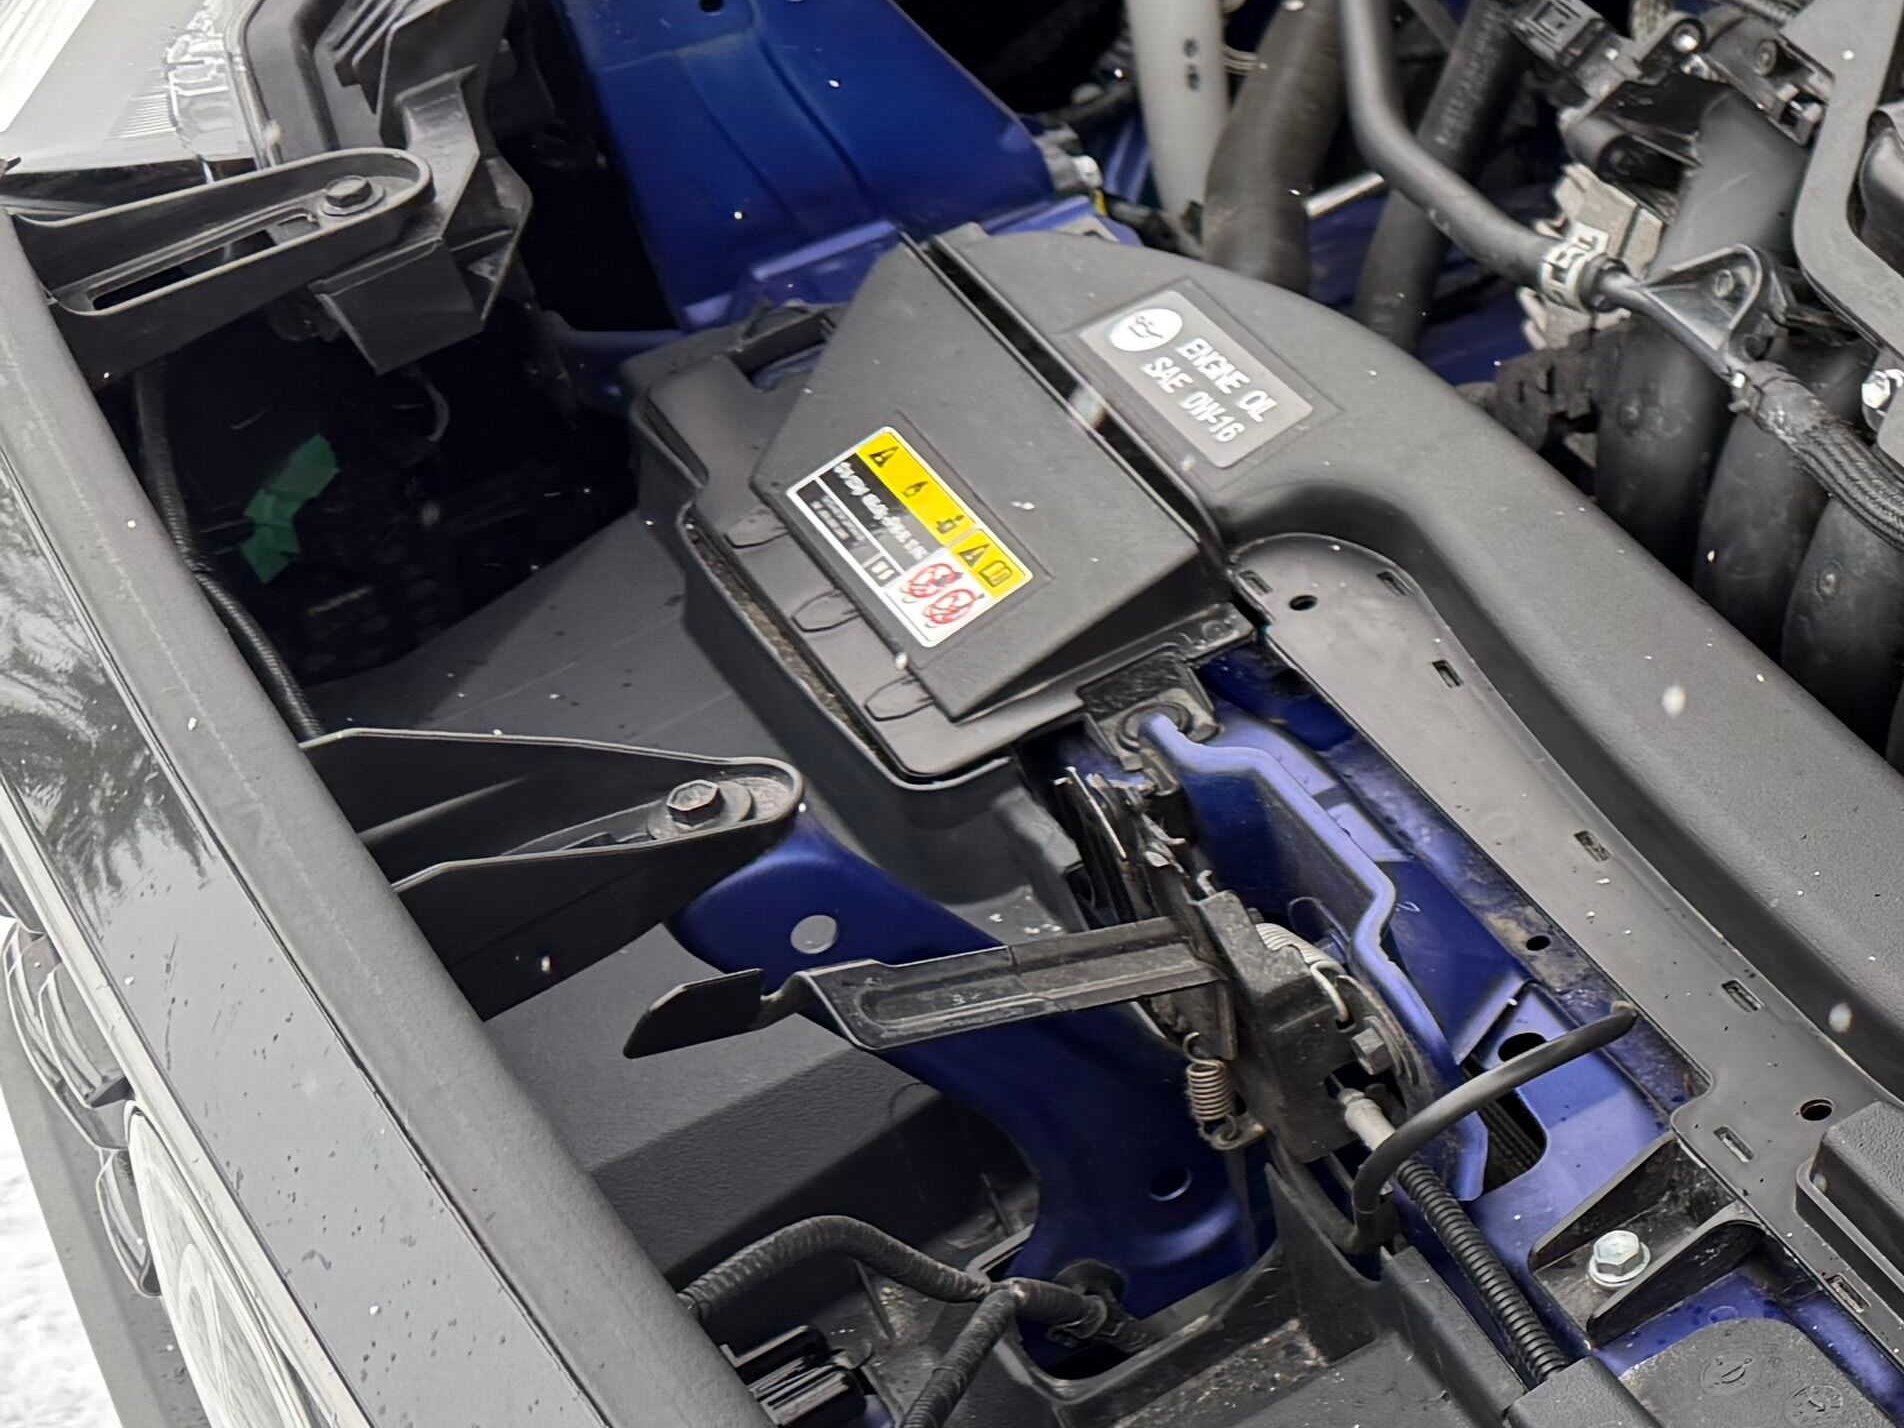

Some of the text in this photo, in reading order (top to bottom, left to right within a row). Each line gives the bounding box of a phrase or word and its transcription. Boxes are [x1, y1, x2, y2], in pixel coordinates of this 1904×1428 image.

[1139, 356, 1248, 445] SAE 0W-16
[1174, 338, 1279, 425] ENGINE OIL
